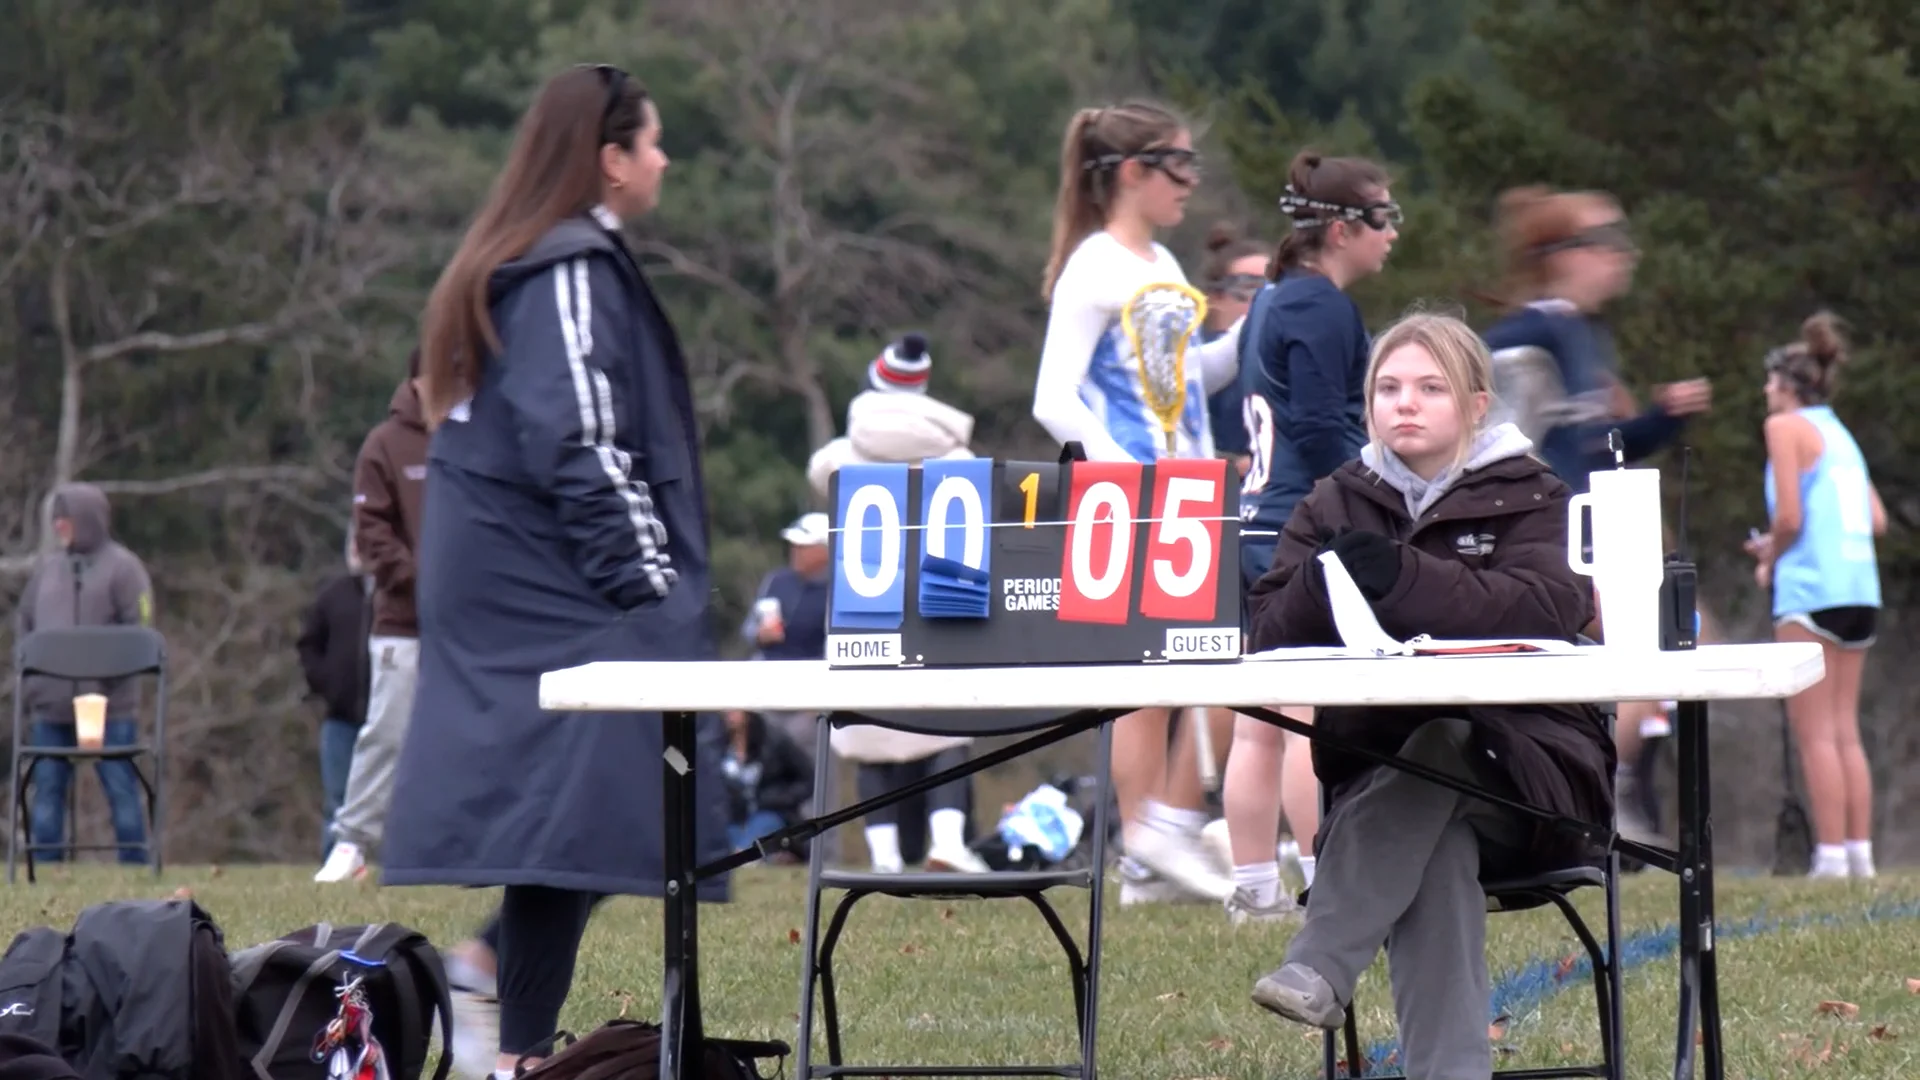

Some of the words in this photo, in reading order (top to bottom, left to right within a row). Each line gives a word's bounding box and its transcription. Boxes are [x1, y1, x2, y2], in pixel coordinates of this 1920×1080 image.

[1019, 472, 1040, 529] 1
[1003, 578, 1062, 594] PERIOD
[1005, 594, 1061, 611] GAMES
[837, 640, 891, 658] HOME
[1172, 635, 1235, 653] GUEST
